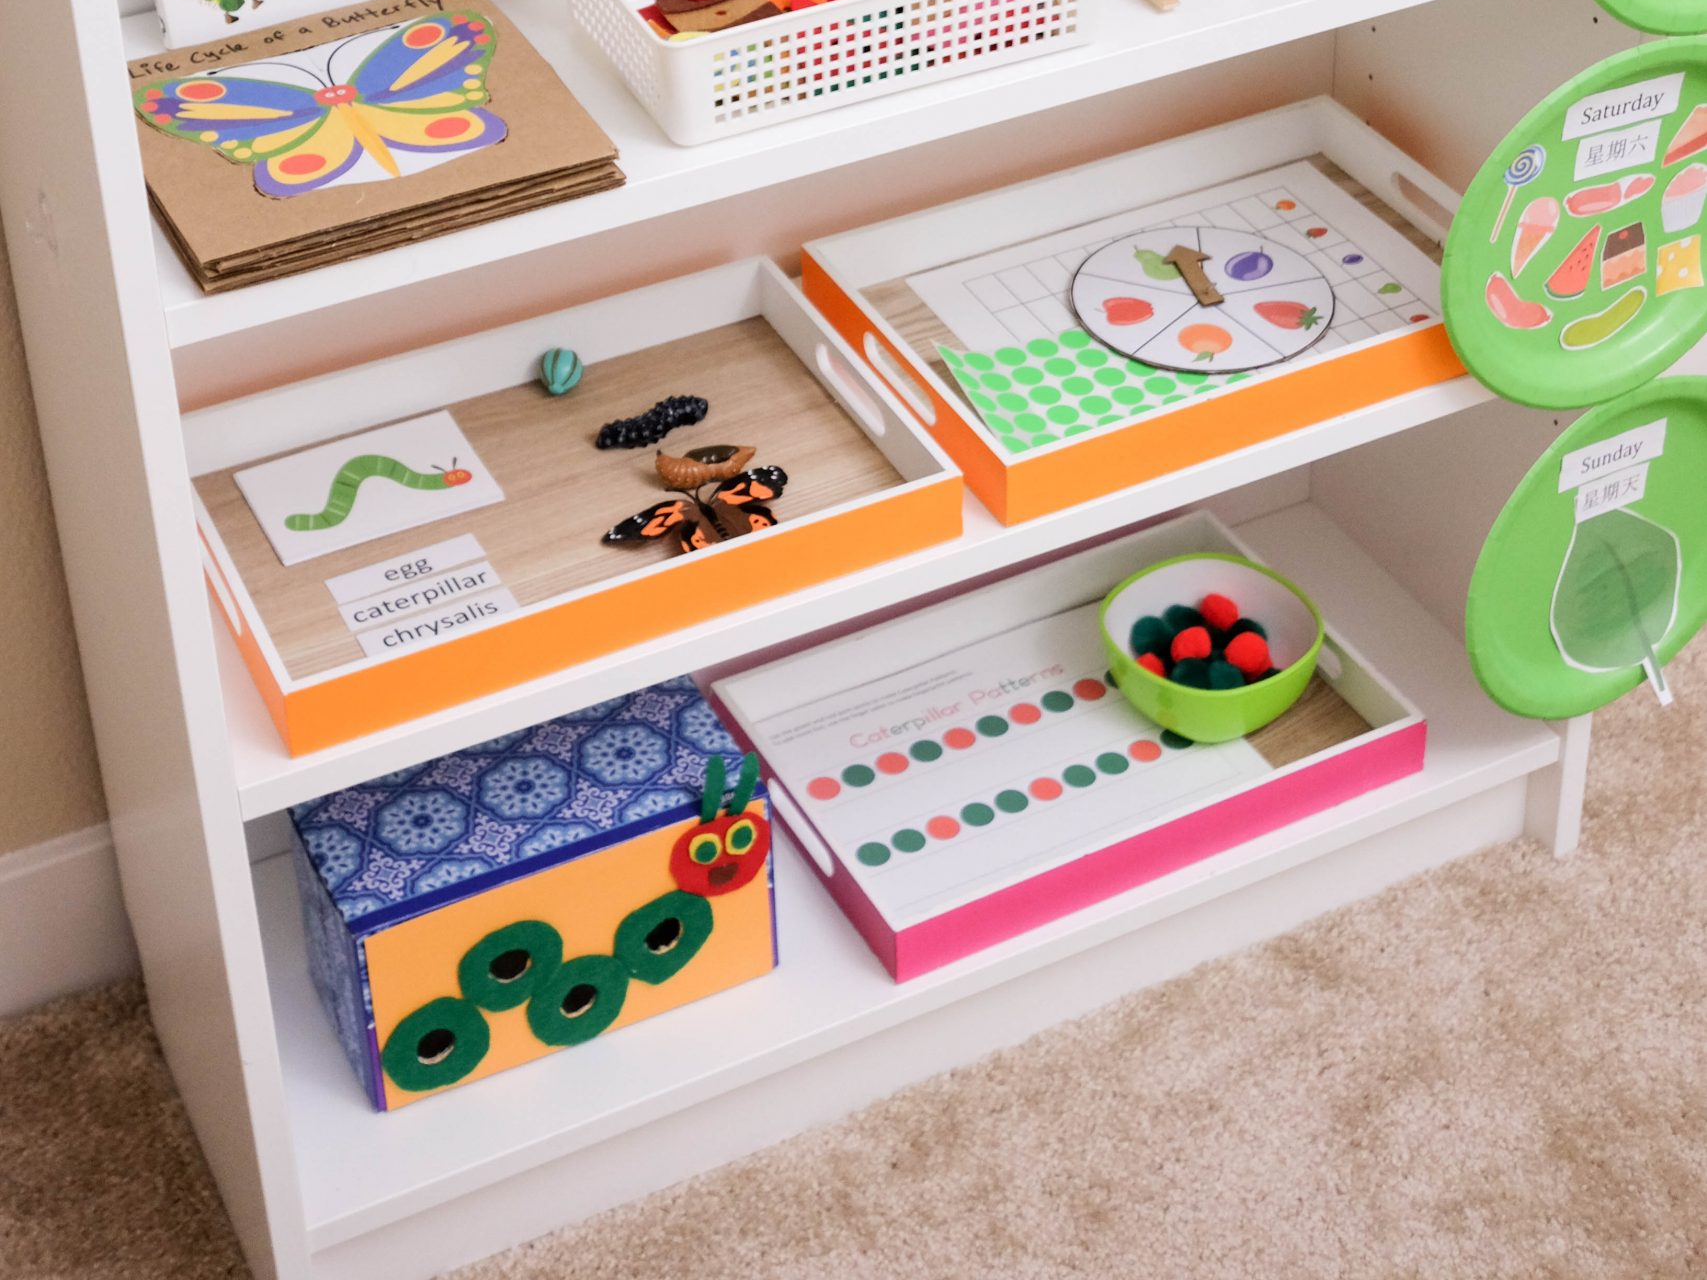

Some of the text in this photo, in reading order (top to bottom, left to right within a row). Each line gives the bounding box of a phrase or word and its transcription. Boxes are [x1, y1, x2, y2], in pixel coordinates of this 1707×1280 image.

[128, 62, 180, 79] Life
[190, 43, 248, 63] Cycle
[264, 30, 285, 44] of
[298, 26, 312, 34] a
[1580, 91, 1665, 126] Saturday
[1584, 134, 1649, 168] 星期六
[1580, 440, 1643, 474] Sunday
[384, 558, 433, 581] egg
[353, 571, 487, 623] caterpillar
[383, 601, 499, 648] chrysalis
[849, 700, 962, 748] Caterpillar
[967, 663, 1065, 705] Patterns
